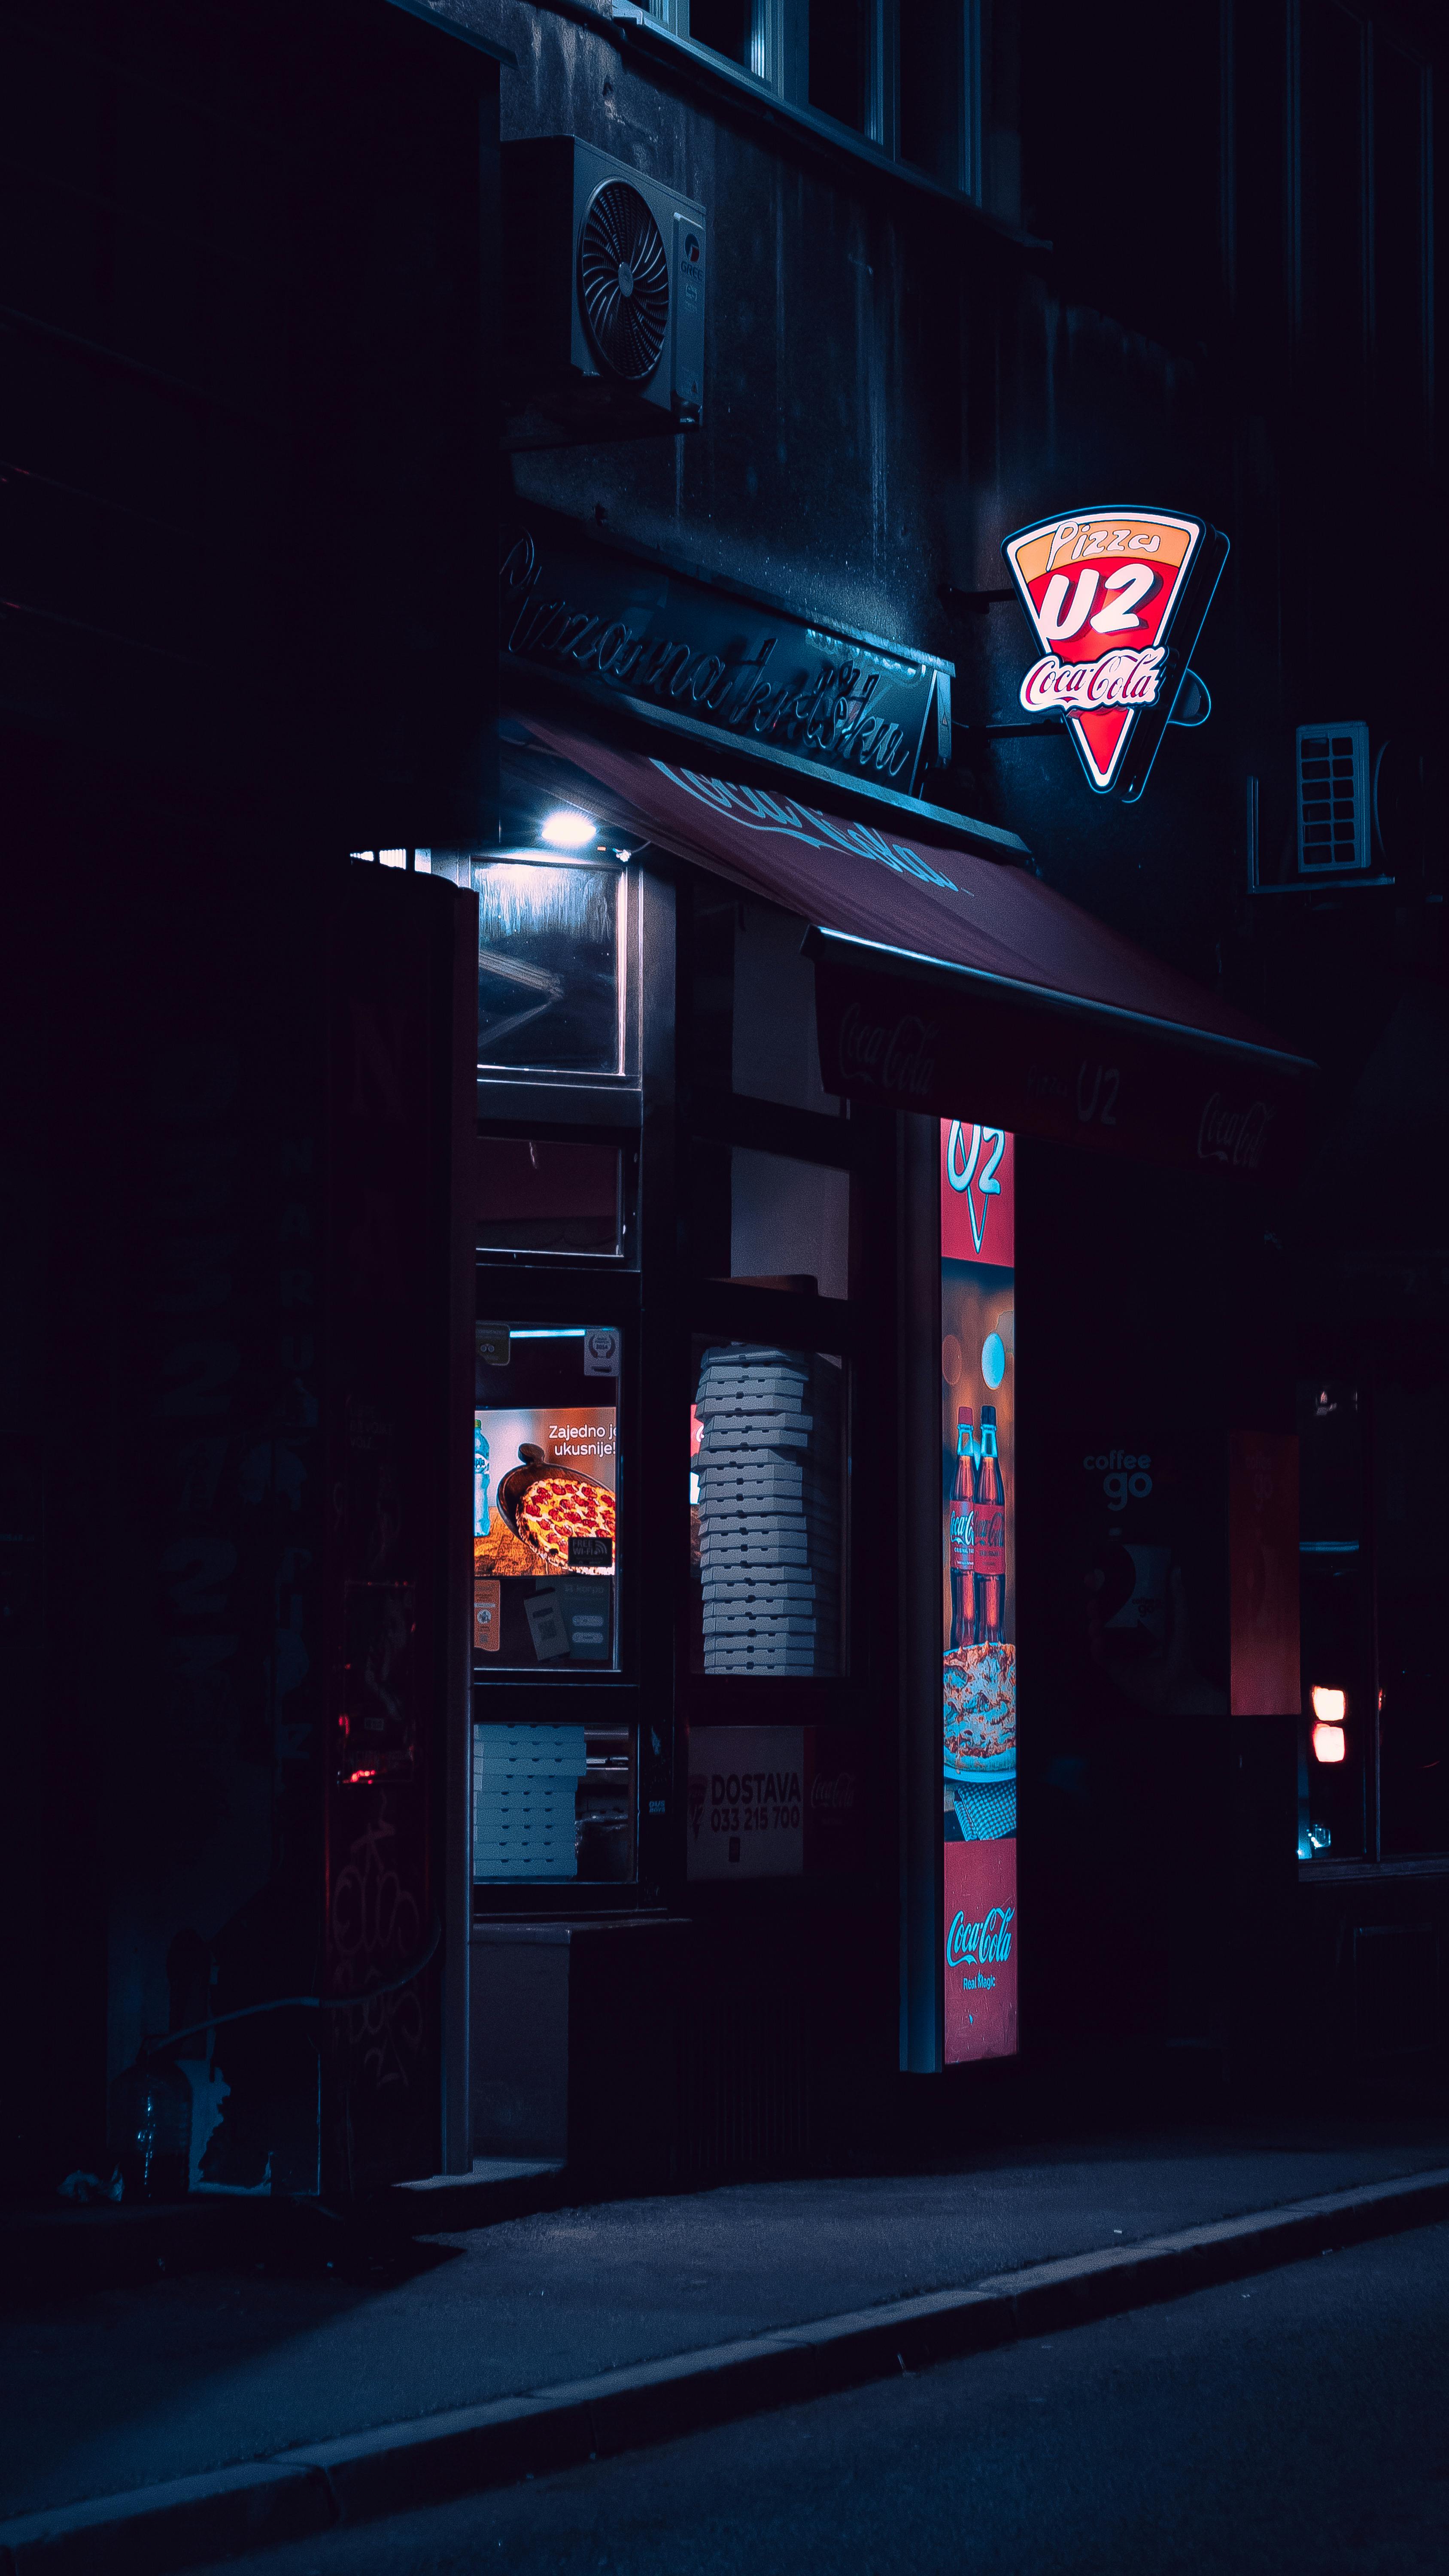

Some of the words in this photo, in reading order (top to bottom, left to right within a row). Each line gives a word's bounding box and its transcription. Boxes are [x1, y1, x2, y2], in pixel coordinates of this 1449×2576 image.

[680, 261, 704, 282] GREE
[1046, 521, 1161, 571] Pizza
[1038, 563, 1155, 640] U2
[1025, 653, 1159, 705] Coca-Cola
[1077, 1060, 1121, 1126] U2
[947, 1120, 1005, 1196] U2
[549, 1424, 605, 1441] Zajedno
[555, 1442, 616, 1457] ukusnije!
[1083, 1449, 1152, 1470] coffee
[1103, 1472, 1153, 1512] go
[573, 1539, 592, 1548] FREE
[711, 1773, 801, 1805] DOSTAVA
[711, 1808, 740, 1833] 033
[744, 1807, 768, 1831] 215
[773, 1806, 800, 1828] 700
[946, 1906, 1015, 1967] Coca-Cola
[963, 1976, 977, 1990] Real
[978, 1974, 996, 1990] Magic
